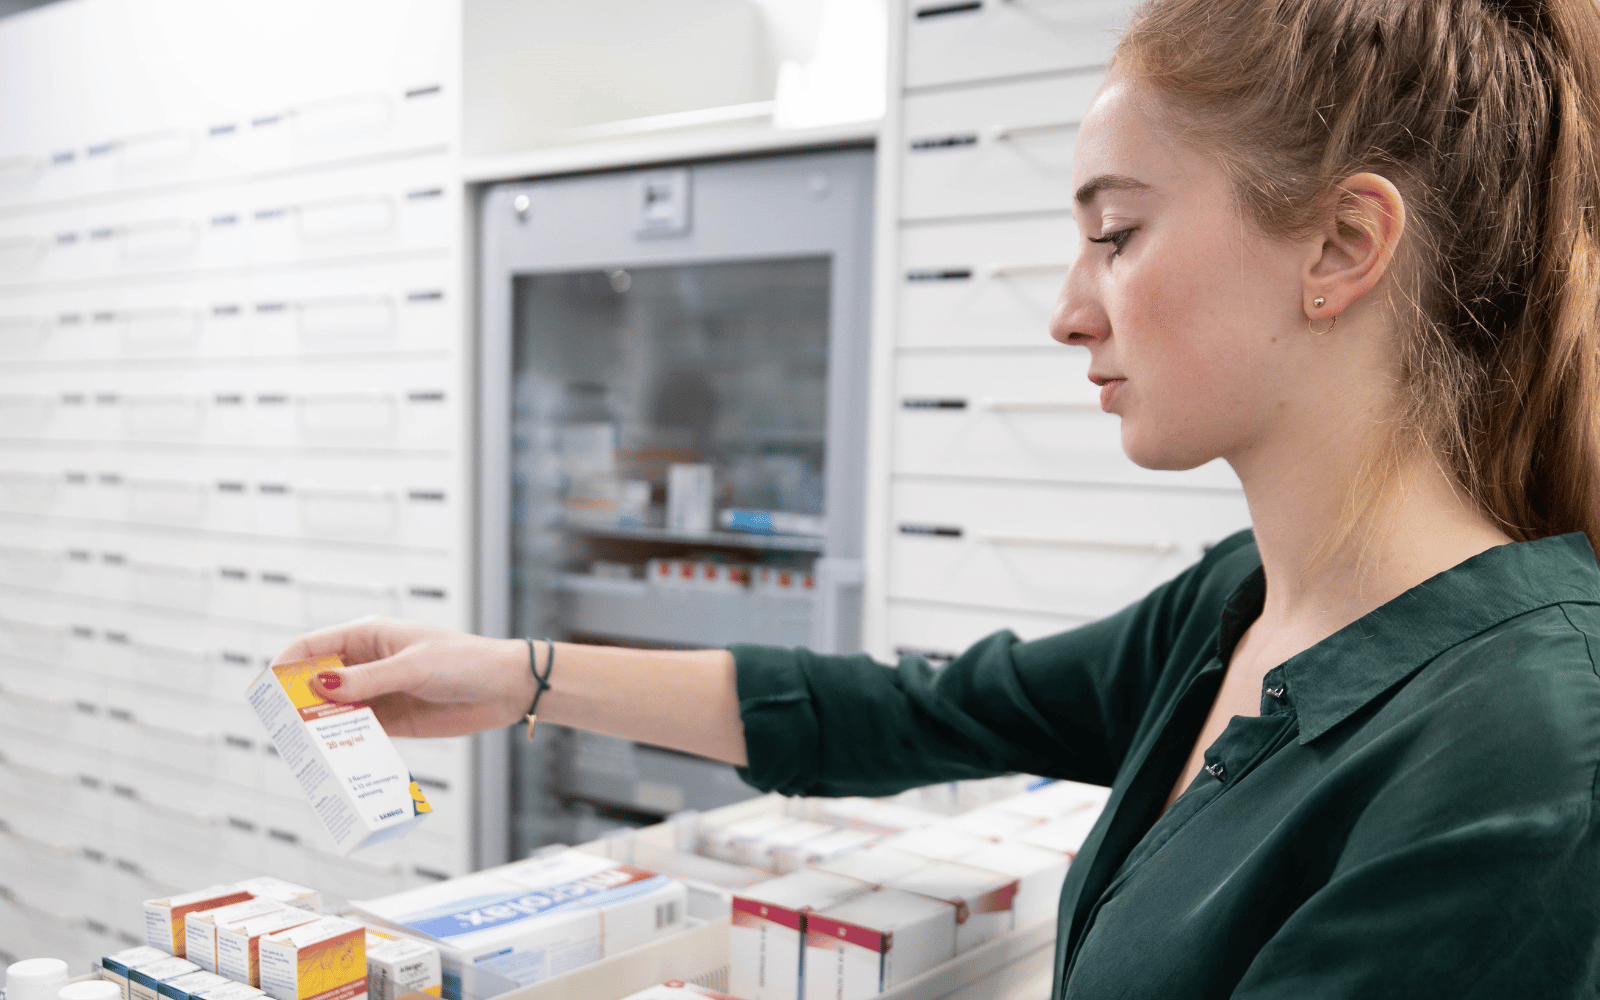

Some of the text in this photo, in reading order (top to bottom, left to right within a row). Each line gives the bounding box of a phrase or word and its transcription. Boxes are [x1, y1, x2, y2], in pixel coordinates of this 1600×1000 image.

[326, 734, 365, 750] 20 mg/ml
[379, 808, 403, 820] SANDOZ
